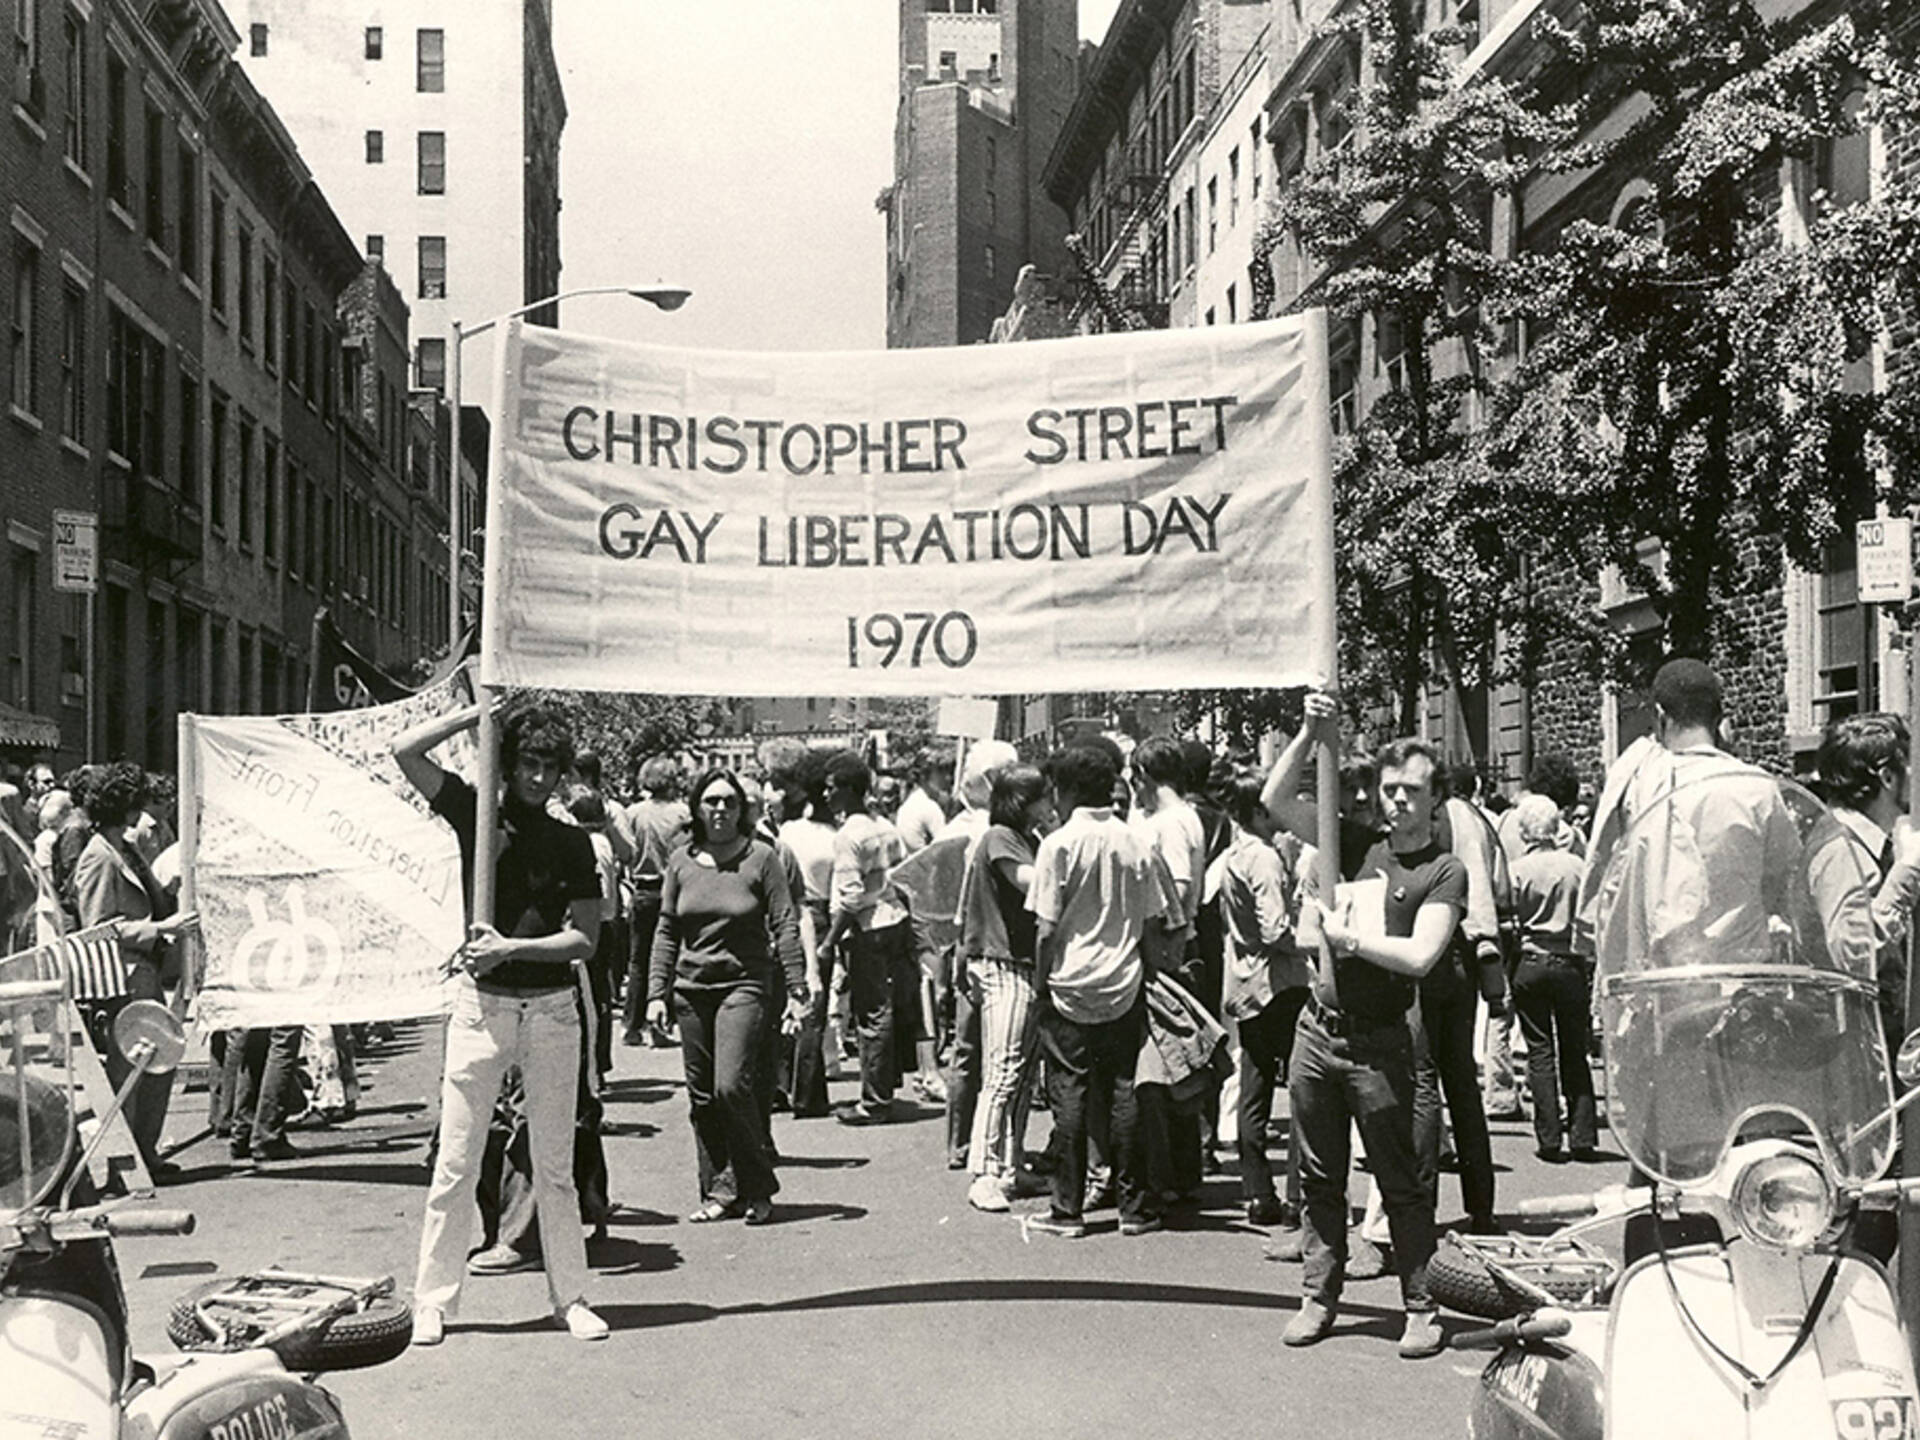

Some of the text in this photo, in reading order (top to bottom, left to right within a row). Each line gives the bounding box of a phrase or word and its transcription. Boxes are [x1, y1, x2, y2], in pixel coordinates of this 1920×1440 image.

[562, 396, 1238, 476] CHRISTOPHER STREET
[56, 523, 75, 543] NO
[599, 493, 1233, 568] GAY LIBERATION DAY
[1860, 523, 1883, 545] NO
[848, 609, 978, 669] 1970
[1488, 1355, 1548, 1412] LICE
